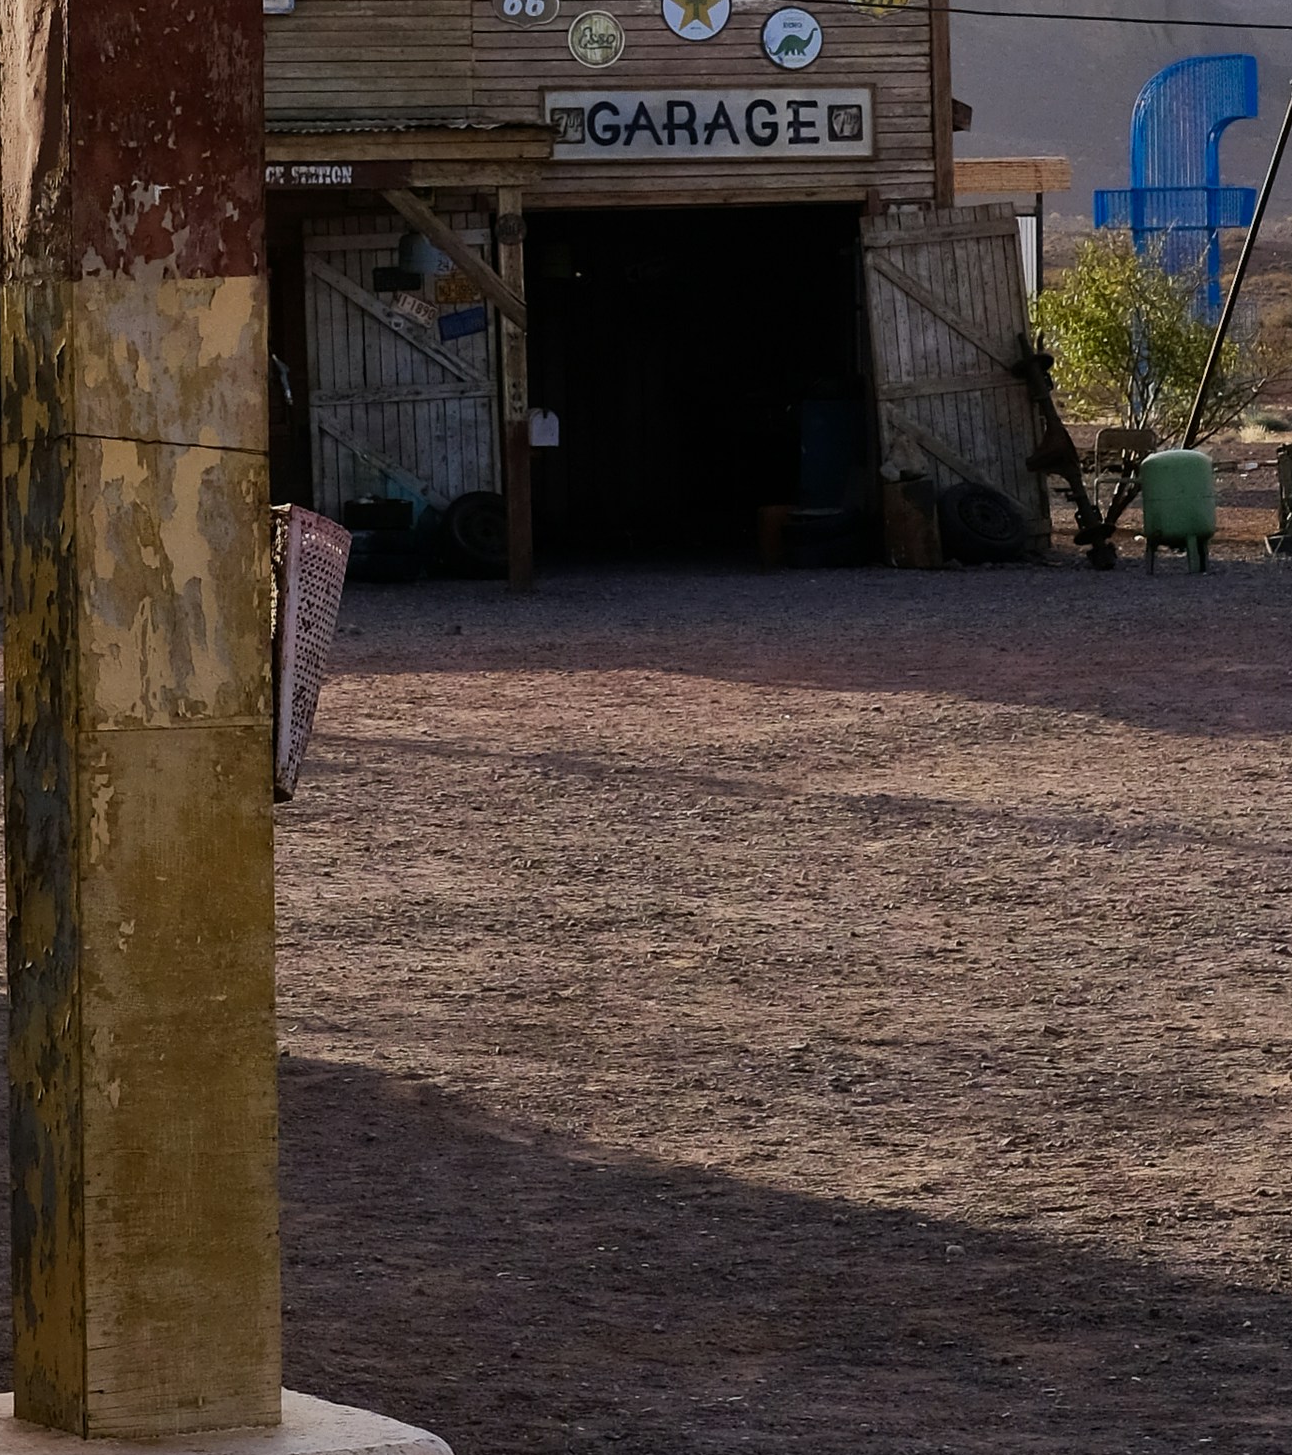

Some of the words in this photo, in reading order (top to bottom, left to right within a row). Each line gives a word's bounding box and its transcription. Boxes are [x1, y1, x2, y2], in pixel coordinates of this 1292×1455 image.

[578, 26, 617, 50] Esso
[587, 99, 820, 147] GARAGE
[291, 165, 353, 184] STATION
